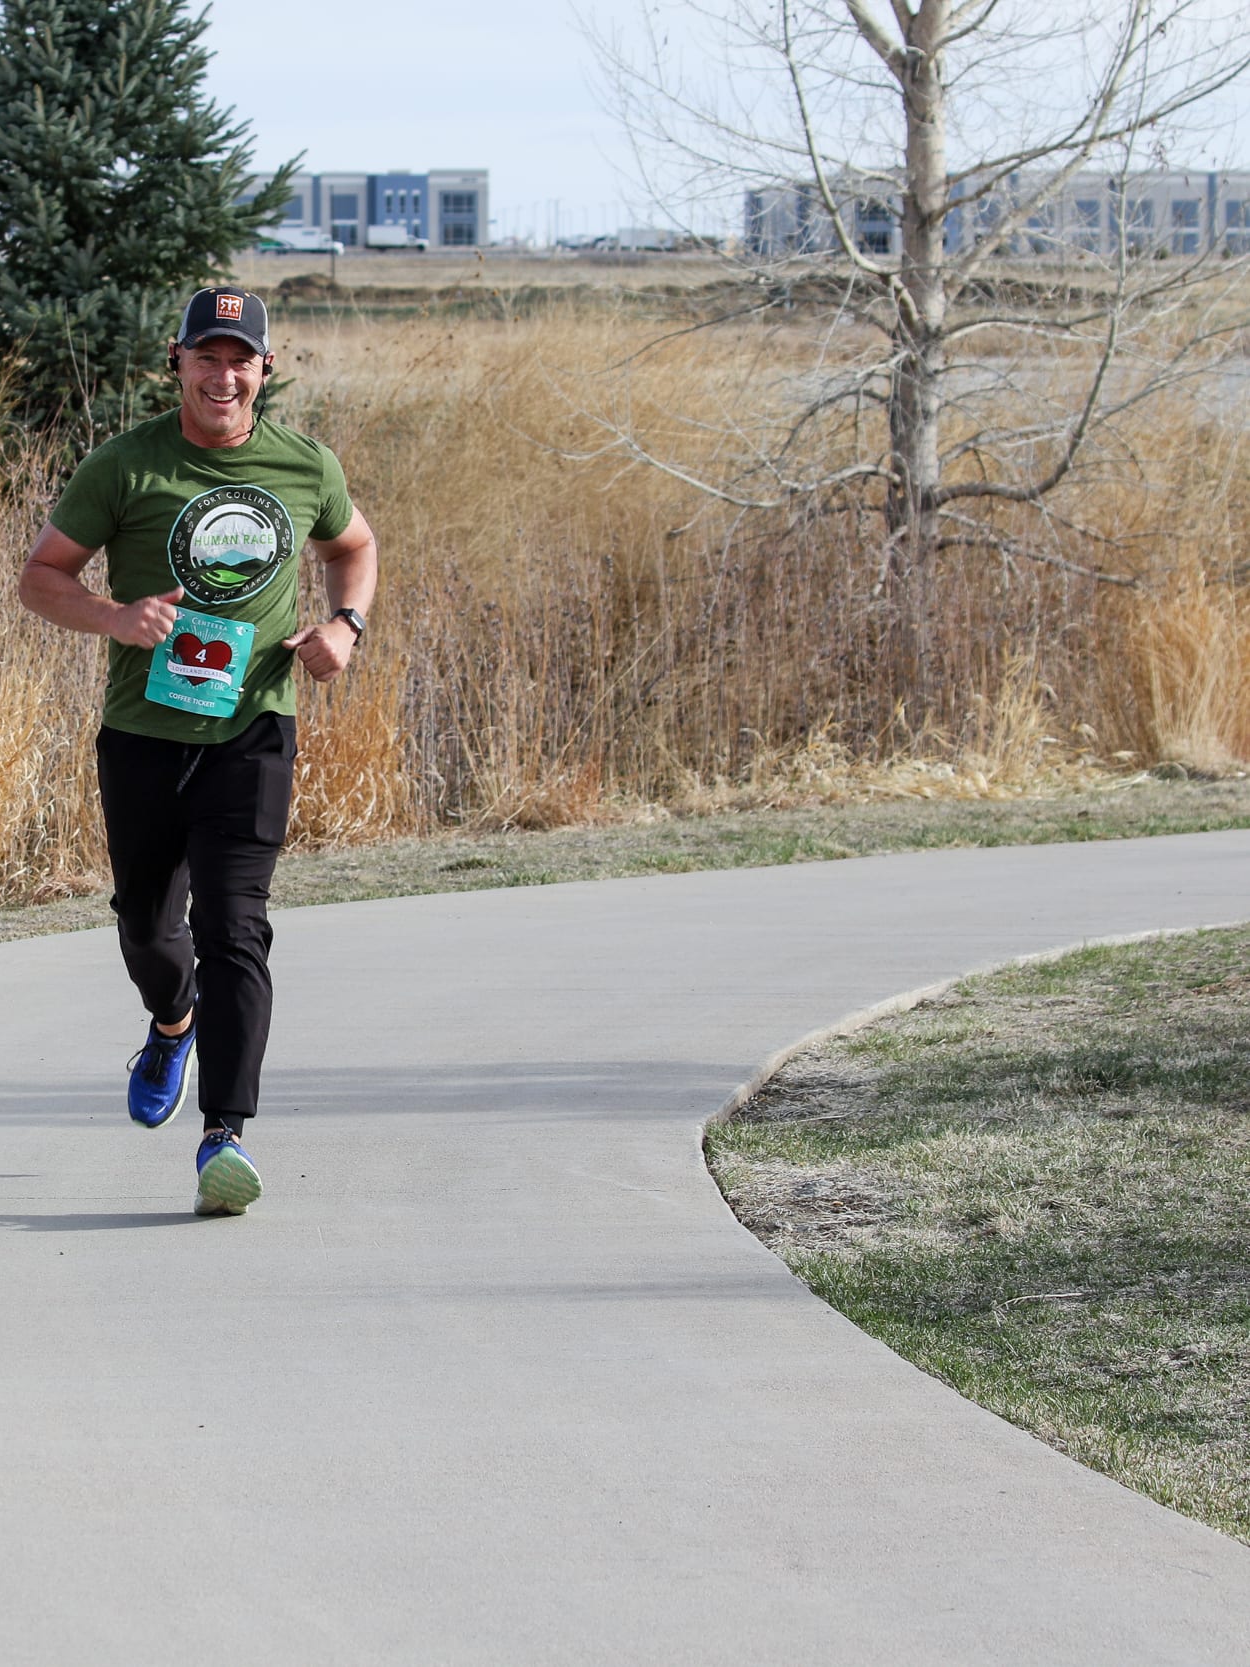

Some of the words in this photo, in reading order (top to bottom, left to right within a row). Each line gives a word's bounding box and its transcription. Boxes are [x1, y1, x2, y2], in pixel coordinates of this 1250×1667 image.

[197, 493, 221, 510] FORT
[226, 491, 272, 509] COLLINS
[194, 534, 239, 547] HUMAN
[243, 533, 274, 546] RACE
[195, 648, 207, 663] 4
[171, 666, 202, 675] LOVELAND
[168, 691, 193, 704] COFFEE
